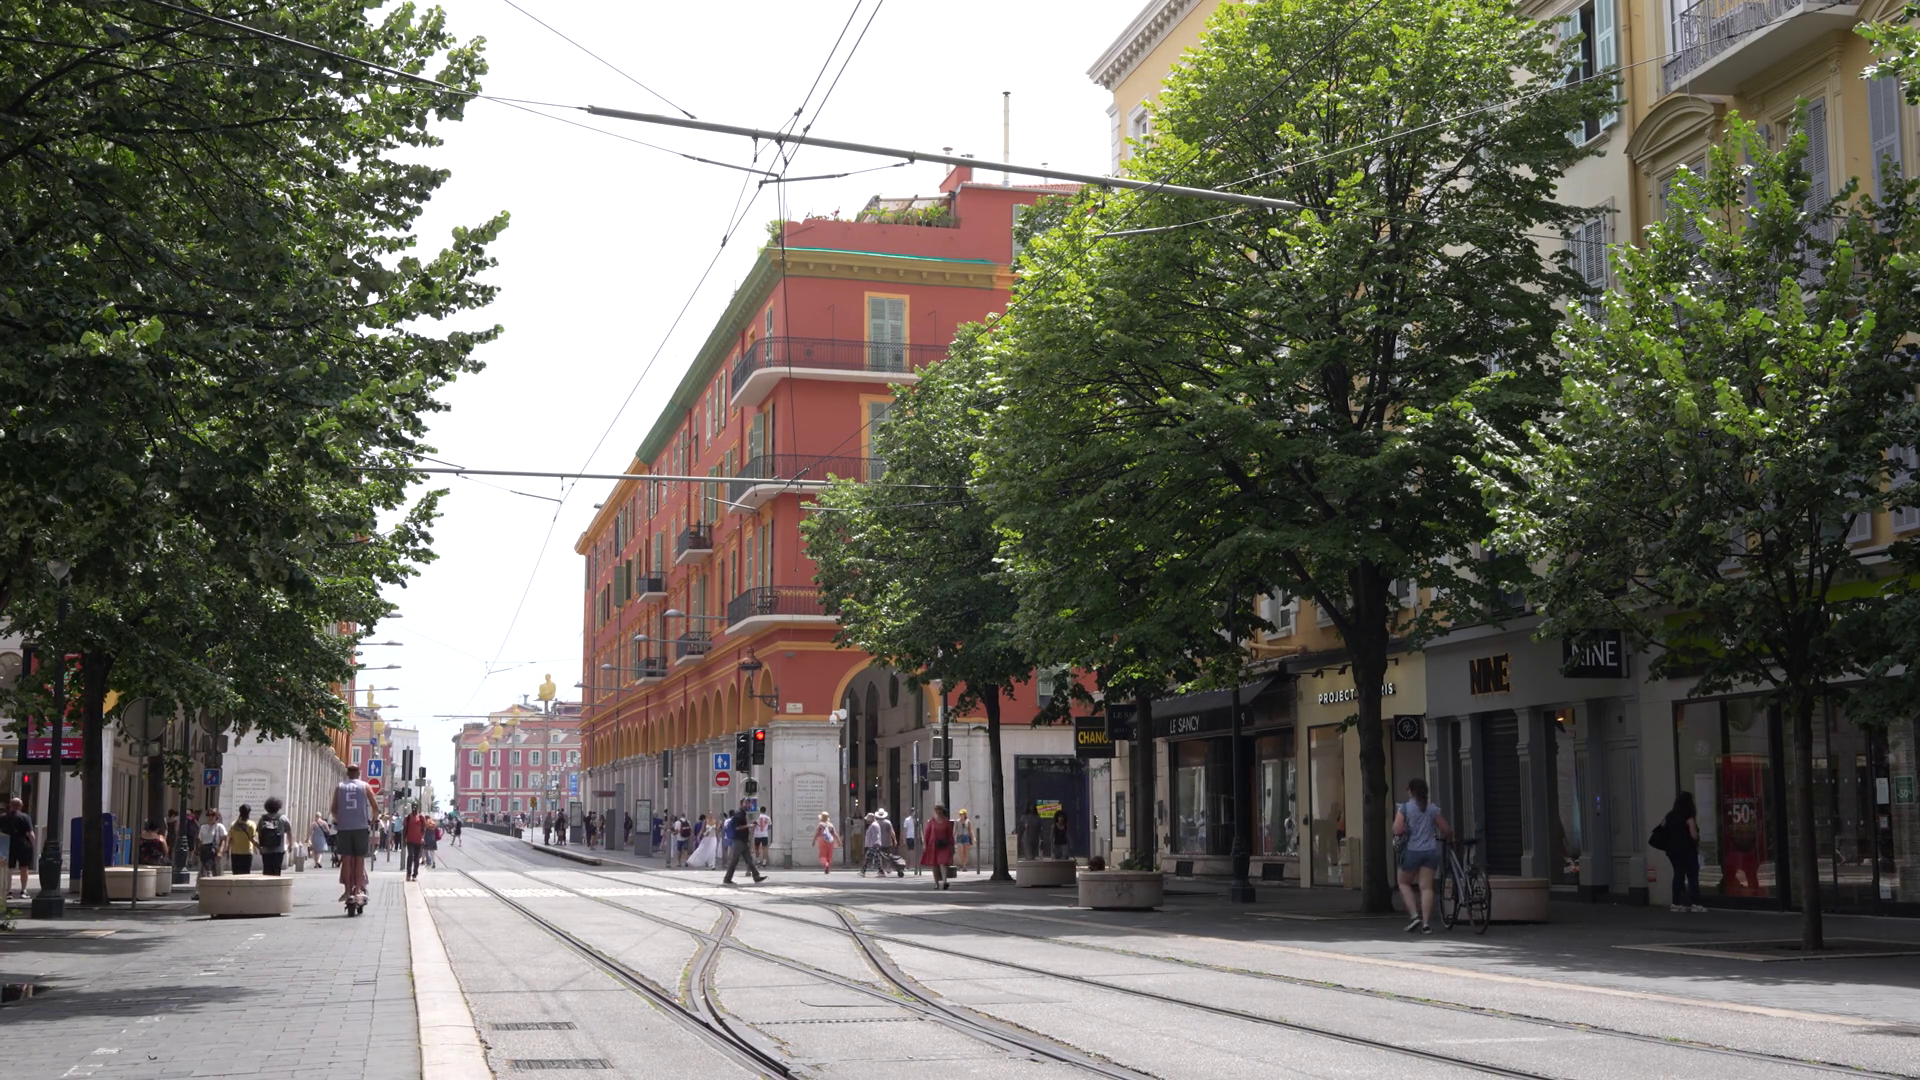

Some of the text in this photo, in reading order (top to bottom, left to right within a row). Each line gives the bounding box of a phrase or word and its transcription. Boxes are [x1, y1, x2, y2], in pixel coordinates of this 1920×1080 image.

[1570, 640, 1618, 667] NINE
[1469, 653, 1511, 694] NINE
[1318, 688, 1355, 705] PROJECT
[1169, 715, 1200, 734] LE SANCY
[1617, 715, 1623, 724] 9
[1078, 731, 1112, 744] CHANG
[346, 792, 357, 809] 5
[1727, 803, 1757, 824] -50%
